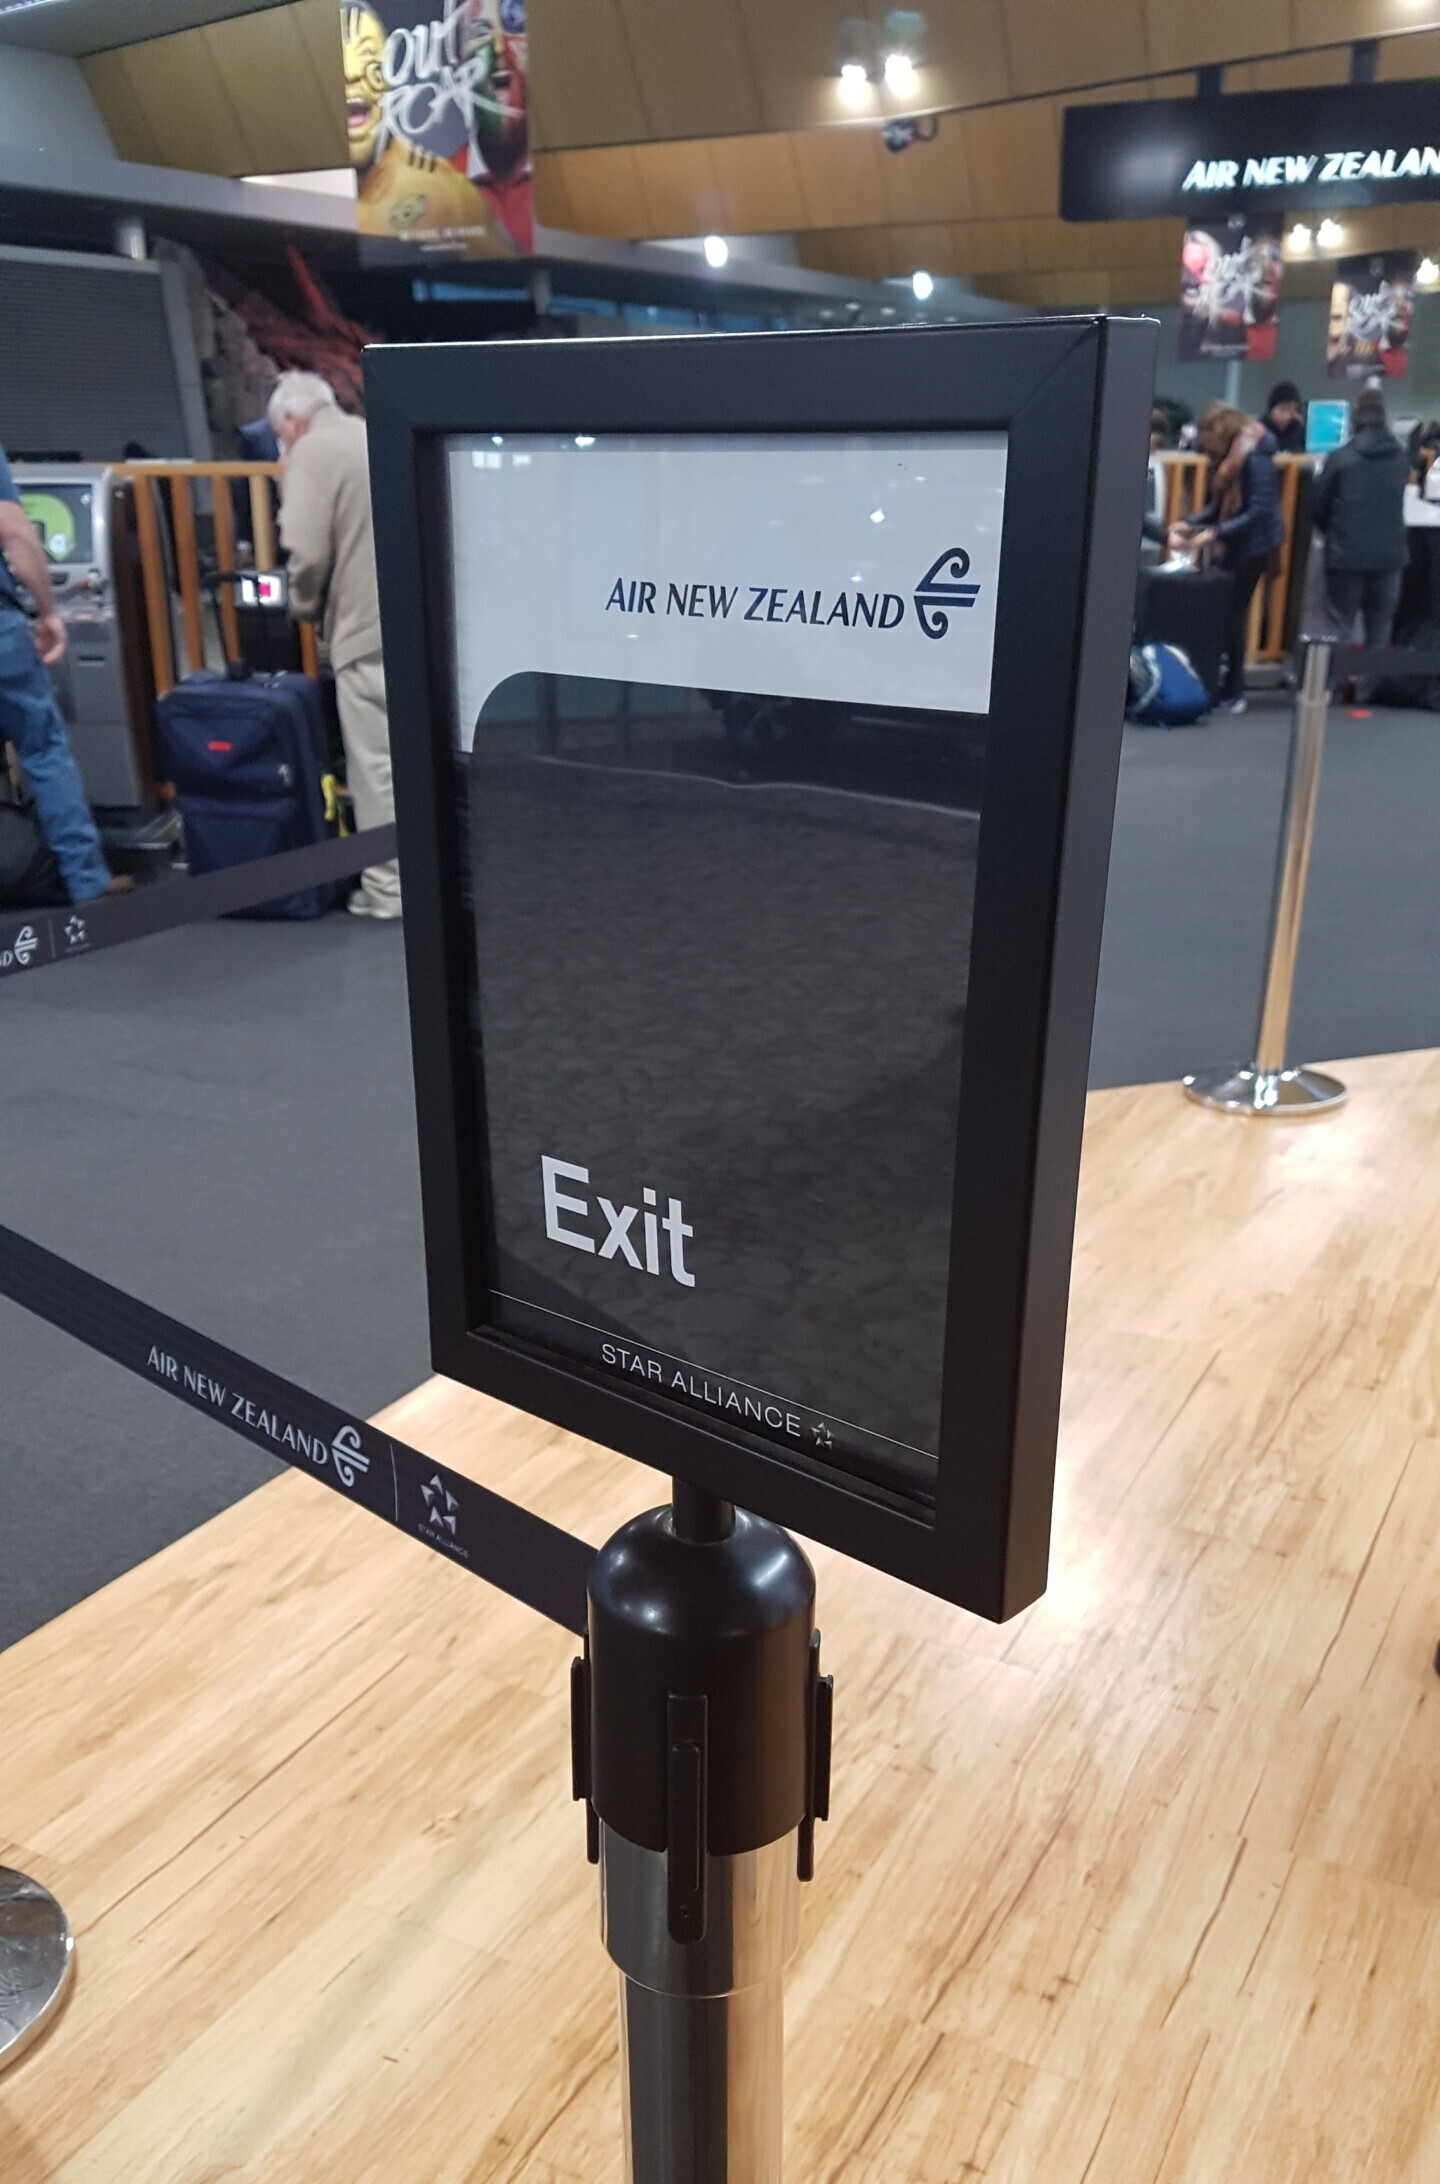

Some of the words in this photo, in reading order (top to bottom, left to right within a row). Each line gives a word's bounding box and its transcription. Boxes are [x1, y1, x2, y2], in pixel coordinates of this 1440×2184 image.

[1182, 159, 1240, 191] AIR
[1242, 154, 1318, 186] NEW
[605, 577, 657, 614] AIR
[666, 583, 739, 619] NEW
[743, 587, 905, 629] ZEALAND
[541, 1154, 696, 1288] Exit
[146, 1344, 178, 1382] AIR
[183, 1365, 226, 1407] NEW
[231, 1392, 328, 1465] ZEALAND
[602, 1343, 663, 1383] STAR
[671, 1370, 801, 1437] ALLIANCE
